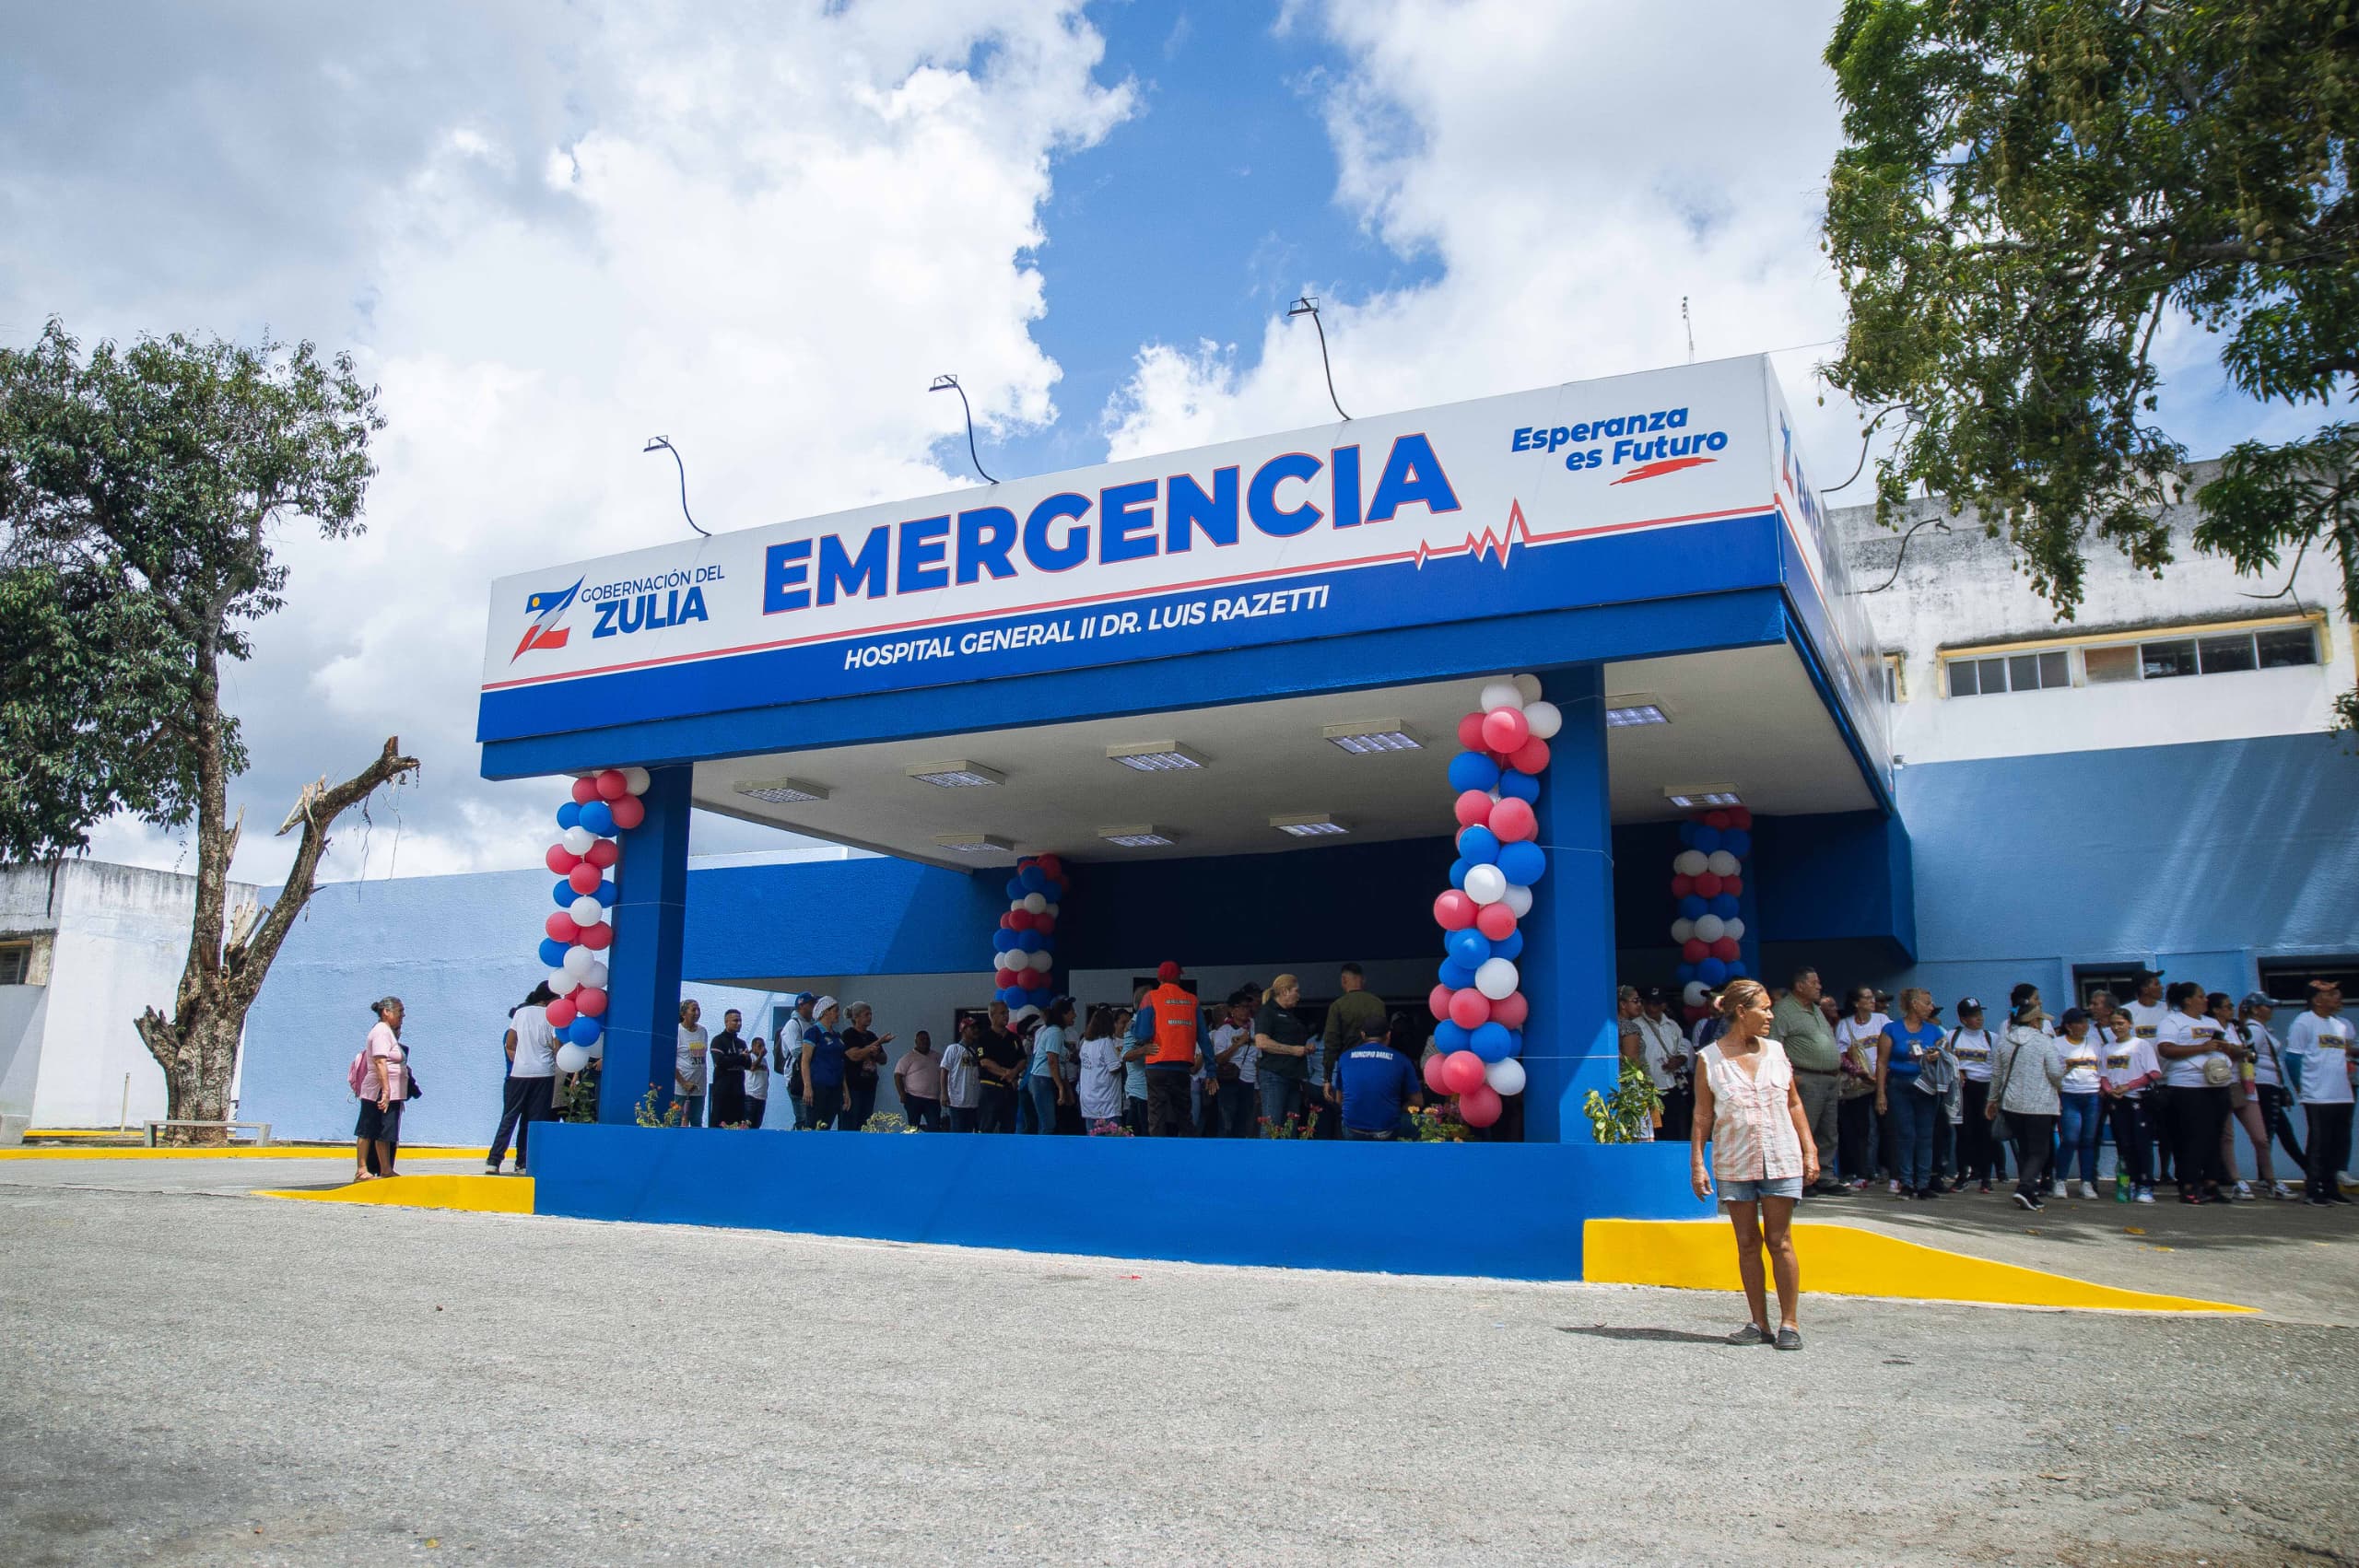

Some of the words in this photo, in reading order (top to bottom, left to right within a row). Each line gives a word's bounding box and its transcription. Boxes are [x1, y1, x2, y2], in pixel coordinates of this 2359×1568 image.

[1511, 407, 1688, 453] Esperanza
[1566, 449, 1603, 472] es
[1613, 431, 1729, 465] Futuro
[763, 432, 1461, 615] EMERGENCIA
[581, 568, 691, 603] GOBERNACIÓN
[696, 565, 725, 583] DEL
[592, 586, 710, 638] ZULIA
[843, 638, 956, 671] HOSPITAL
[959, 620, 1074, 655] GENERAL
[1079, 616, 1096, 639] II
[1099, 612, 1142, 638] DR.
[1148, 602, 1207, 631] LUIS
[1211, 585, 1330, 623] RAZETTI
